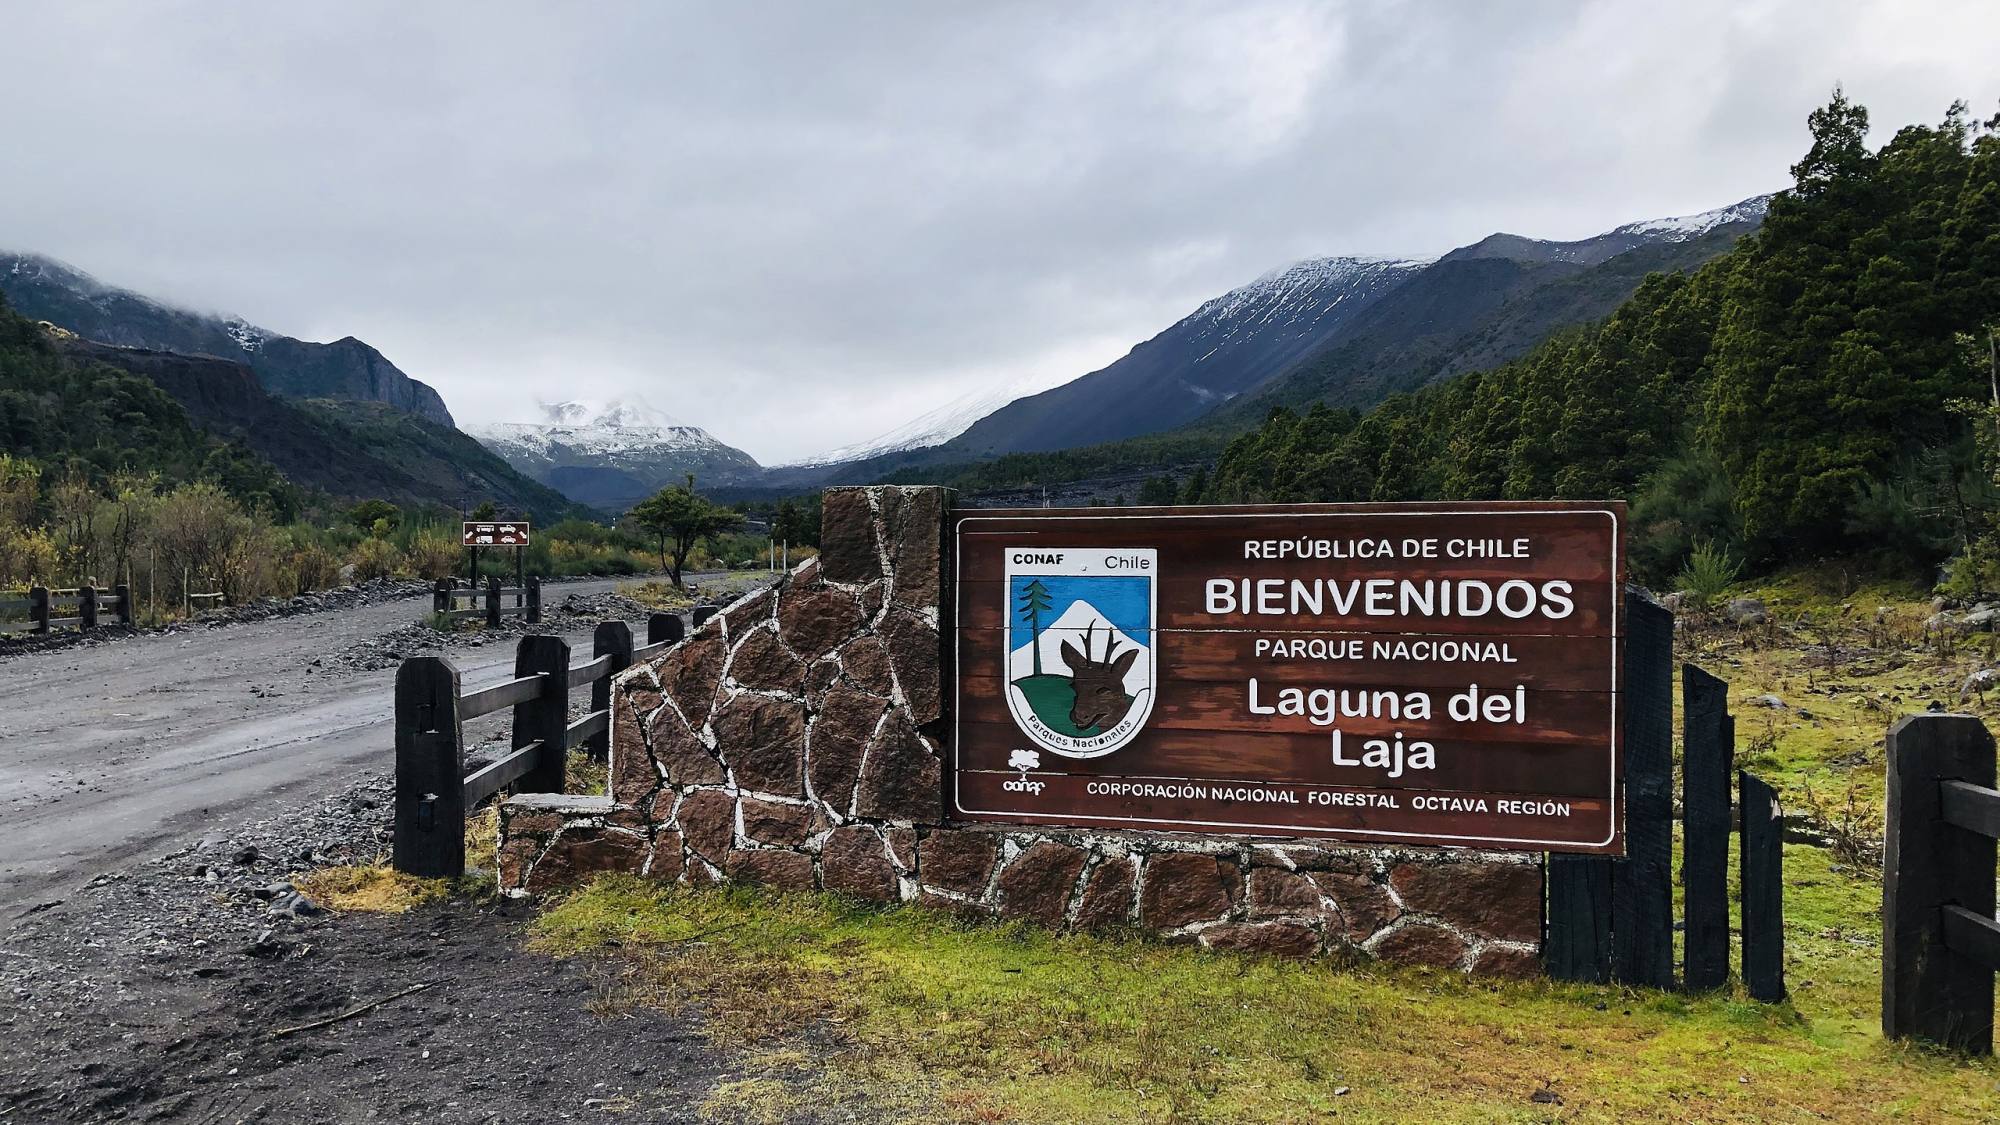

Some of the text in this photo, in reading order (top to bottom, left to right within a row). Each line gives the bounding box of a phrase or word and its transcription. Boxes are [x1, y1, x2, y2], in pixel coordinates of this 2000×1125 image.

[1013, 553, 1064, 565] CONAF
[1104, 555, 1150, 570] Chile
[1244, 536, 1530, 559] REPÚBLICA DE CHILE
[1205, 578, 1574, 619] BIENVENIDOS
[1255, 638, 1517, 663] PARQUE NACIONAL
[1249, 677, 1525, 726] Laguna del
[1028, 714, 1132, 748] Parques Nacionales
[1332, 729, 1436, 778] Laja
[1087, 783, 1570, 817] CORPORACIÓN NACIONAL FORESTAL OCTAVA REGIÓN
